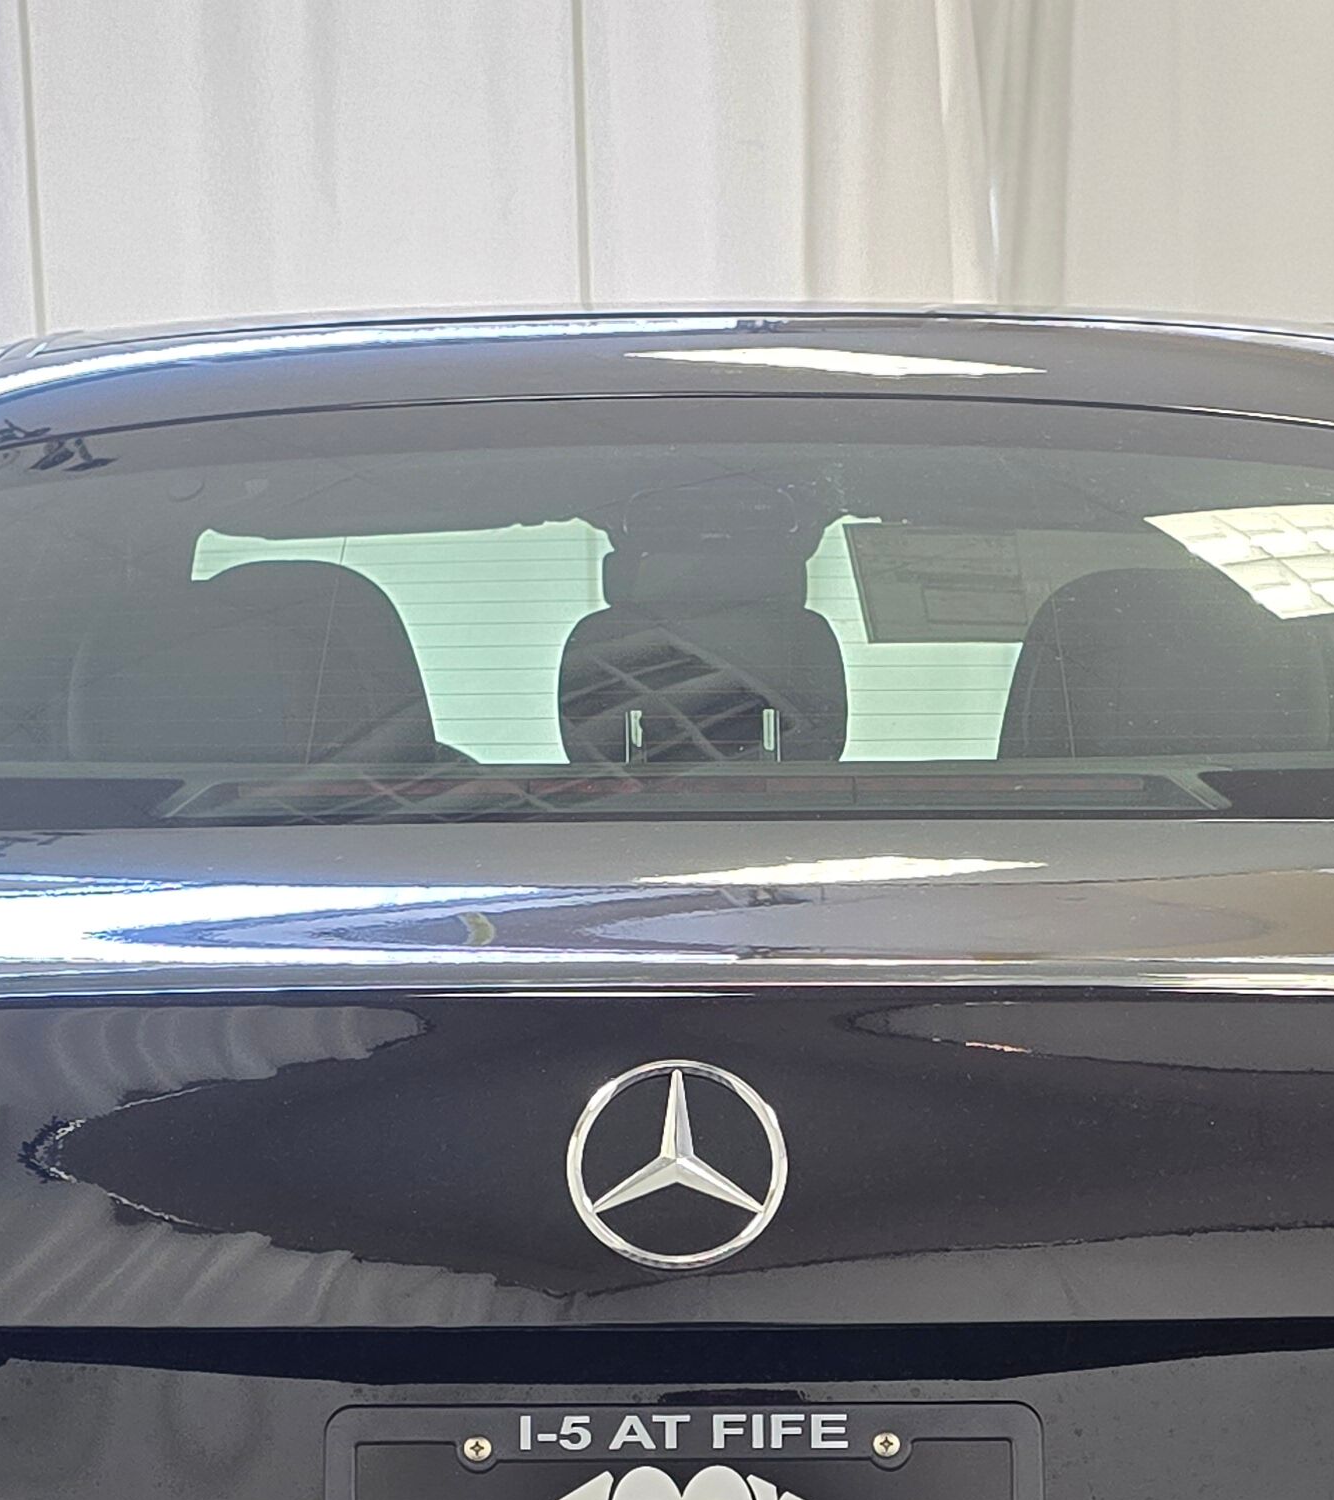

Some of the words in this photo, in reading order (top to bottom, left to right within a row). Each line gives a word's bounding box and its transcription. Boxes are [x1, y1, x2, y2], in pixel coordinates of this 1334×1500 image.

[520, 1415, 592, 1450] I-5
[609, 1414, 691, 1450] AT
[713, 1413, 849, 1449] FIFE
